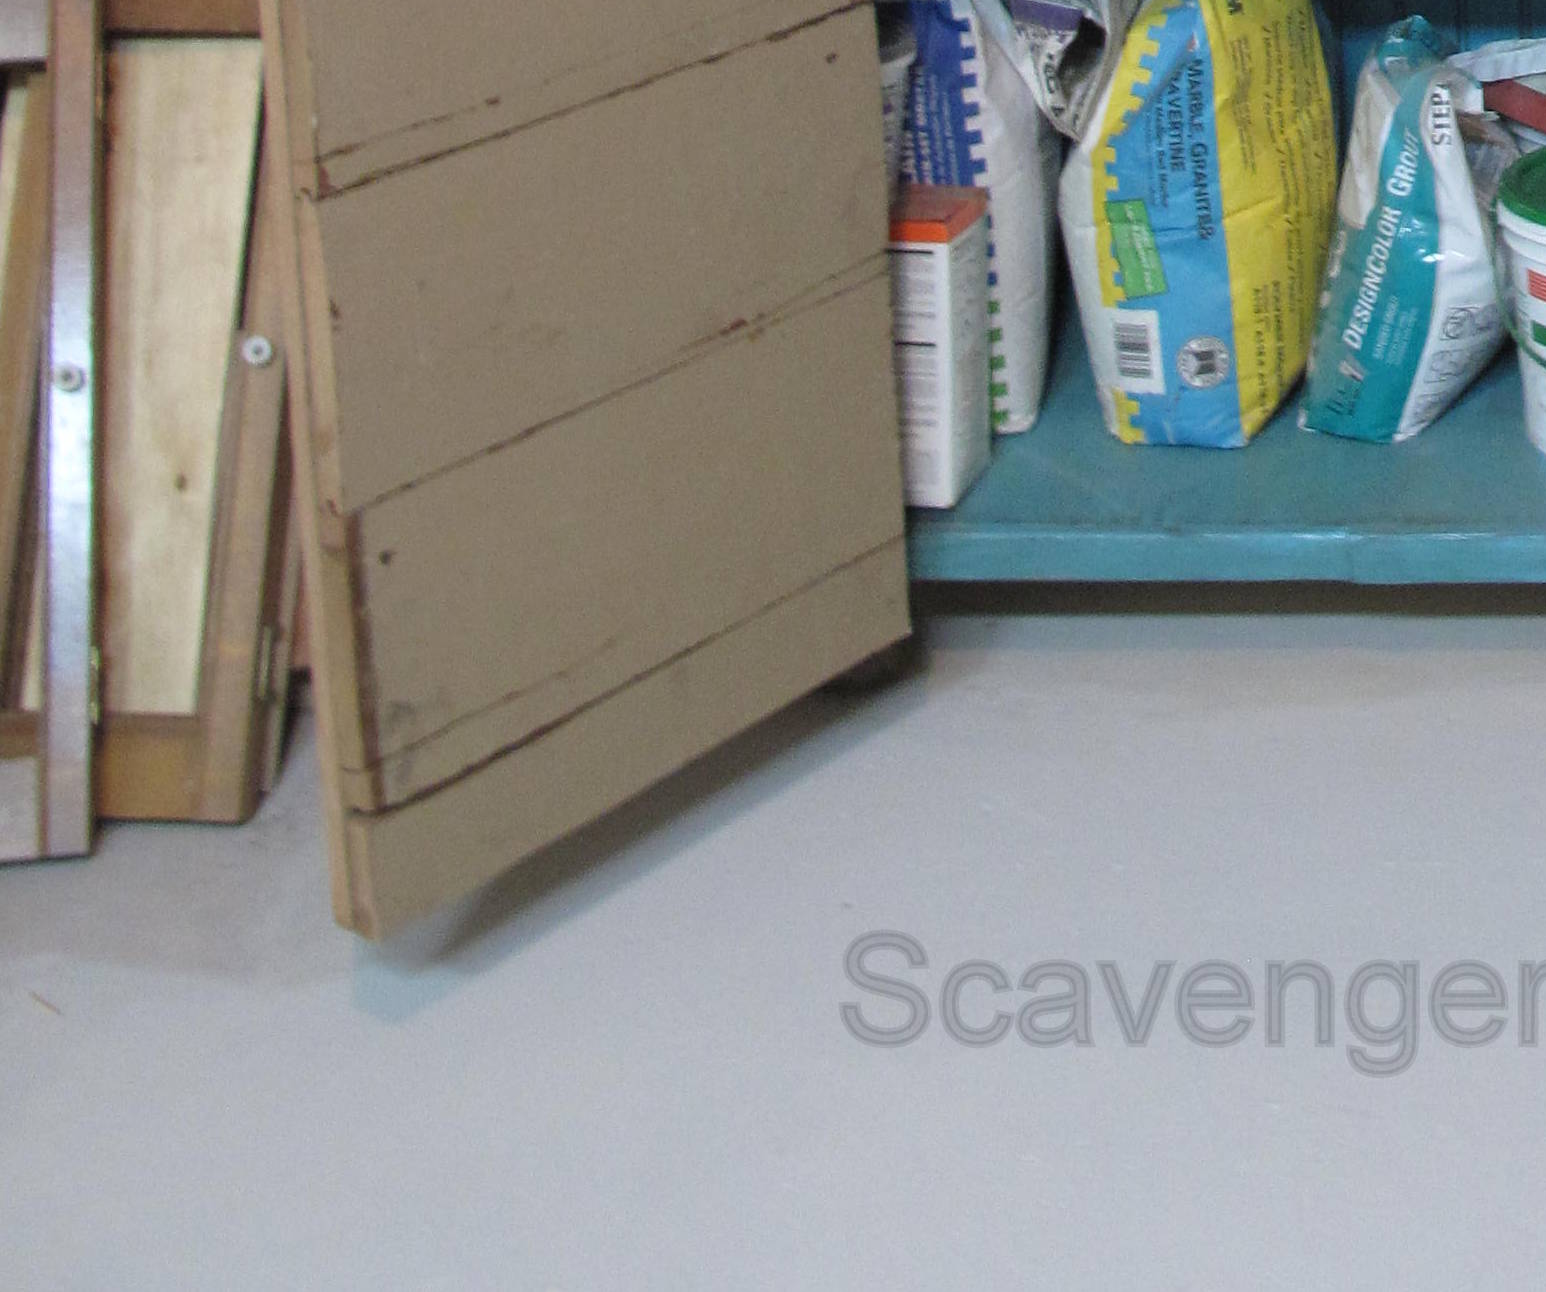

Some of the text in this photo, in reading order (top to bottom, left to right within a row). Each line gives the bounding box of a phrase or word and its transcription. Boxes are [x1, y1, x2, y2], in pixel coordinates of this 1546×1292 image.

[1167, 76, 1186, 173] AVERTINE
[1431, 89, 1452, 146] STEP
[1386, 126, 1420, 196] GROUT
